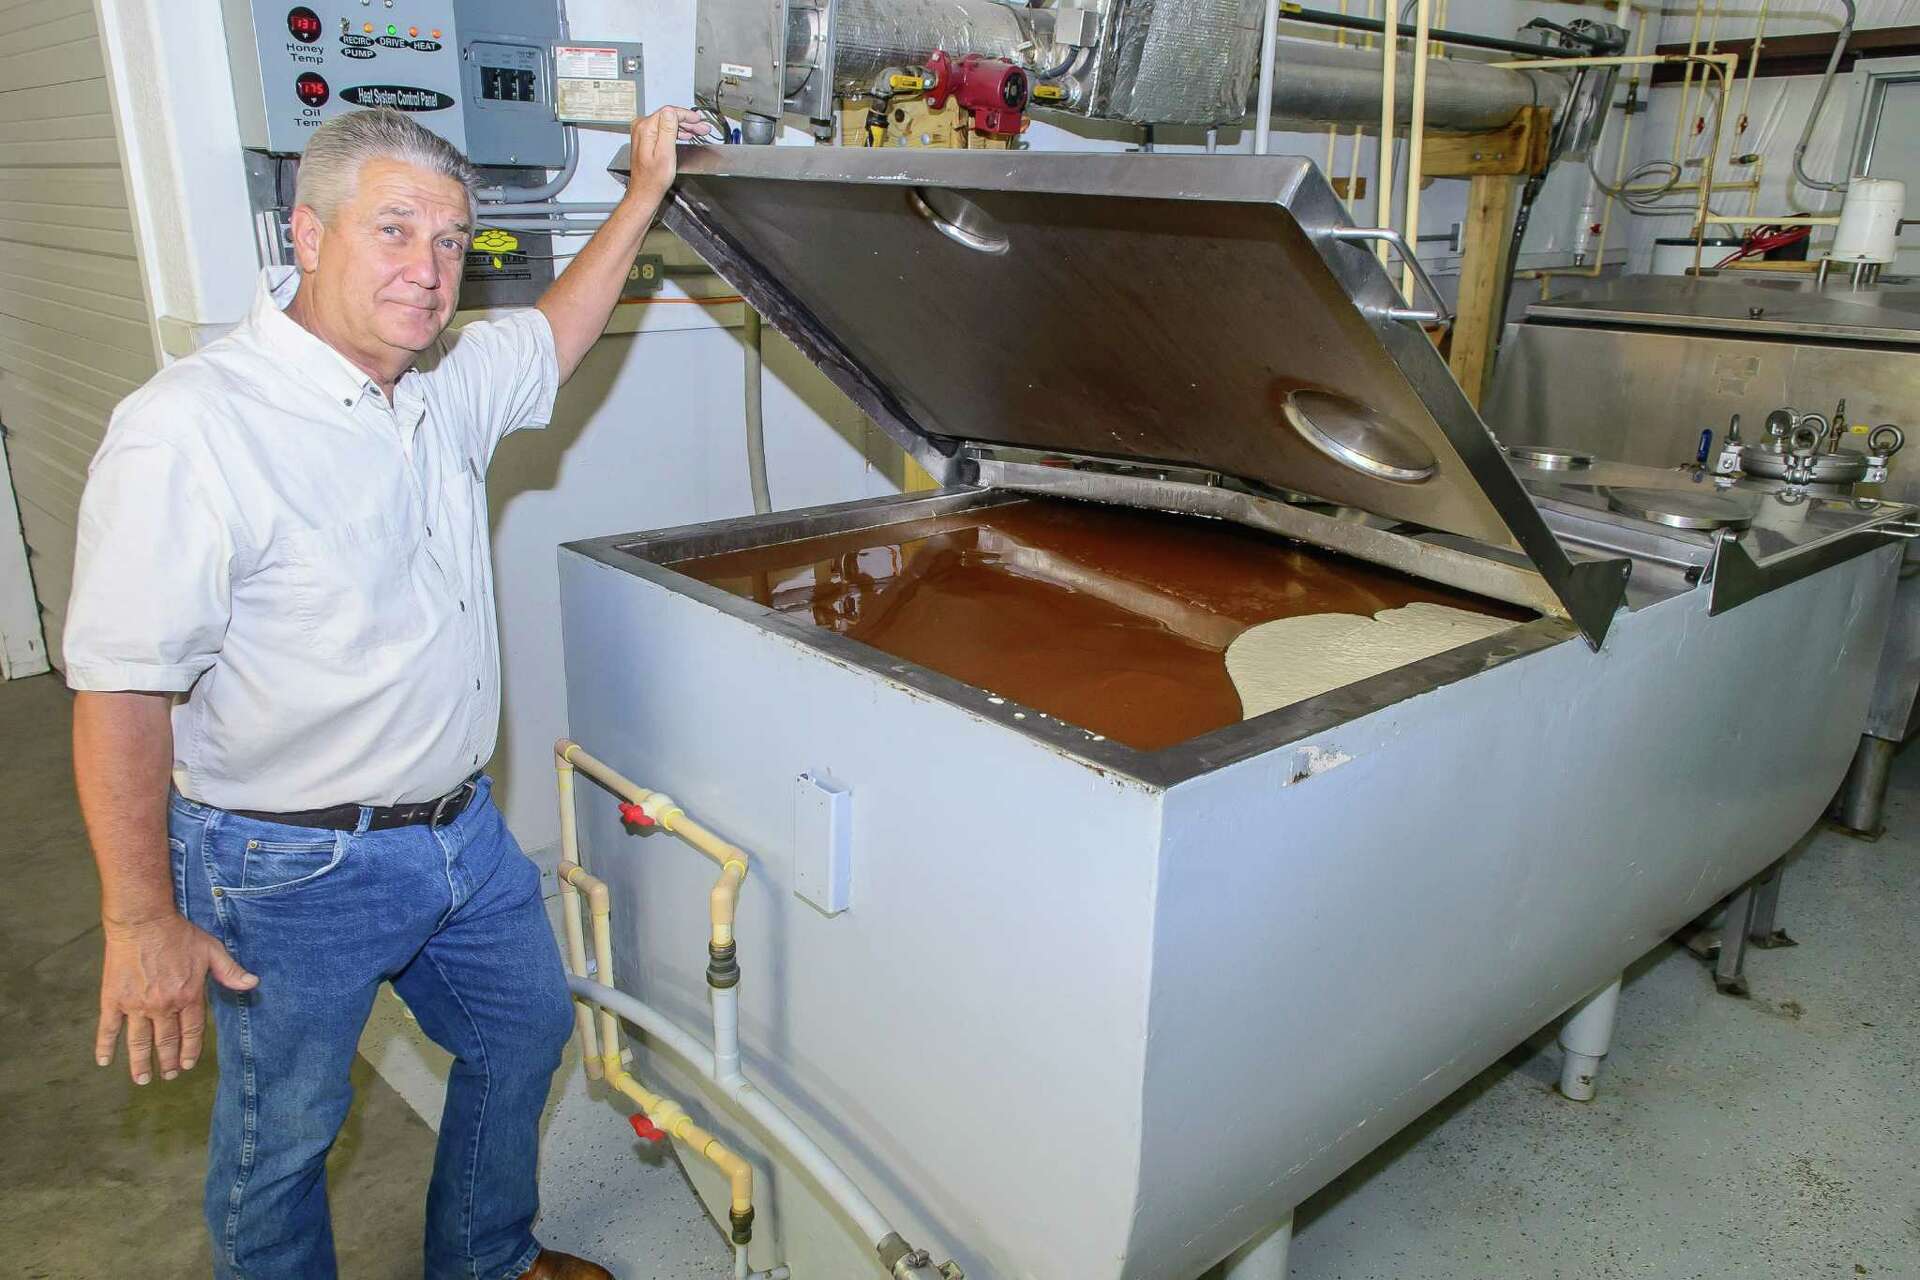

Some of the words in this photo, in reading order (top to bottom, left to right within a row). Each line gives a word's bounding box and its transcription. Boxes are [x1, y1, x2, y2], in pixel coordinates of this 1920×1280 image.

[343, 35, 372, 46] RECIRC
[380, 37, 406, 48] DRIVE
[413, 41, 436, 51] HEAT
[286, 43, 324, 55] Honey
[344, 48, 374, 58] PUMP
[291, 53, 324, 65] Temp
[358, 88, 373, 104] Heat
[373, 88, 397, 106] System
[397, 90, 420, 106] Control
[420, 91, 438, 107] Panel
[302, 108, 321, 117] Oil
[294, 118, 323, 127] Tem
